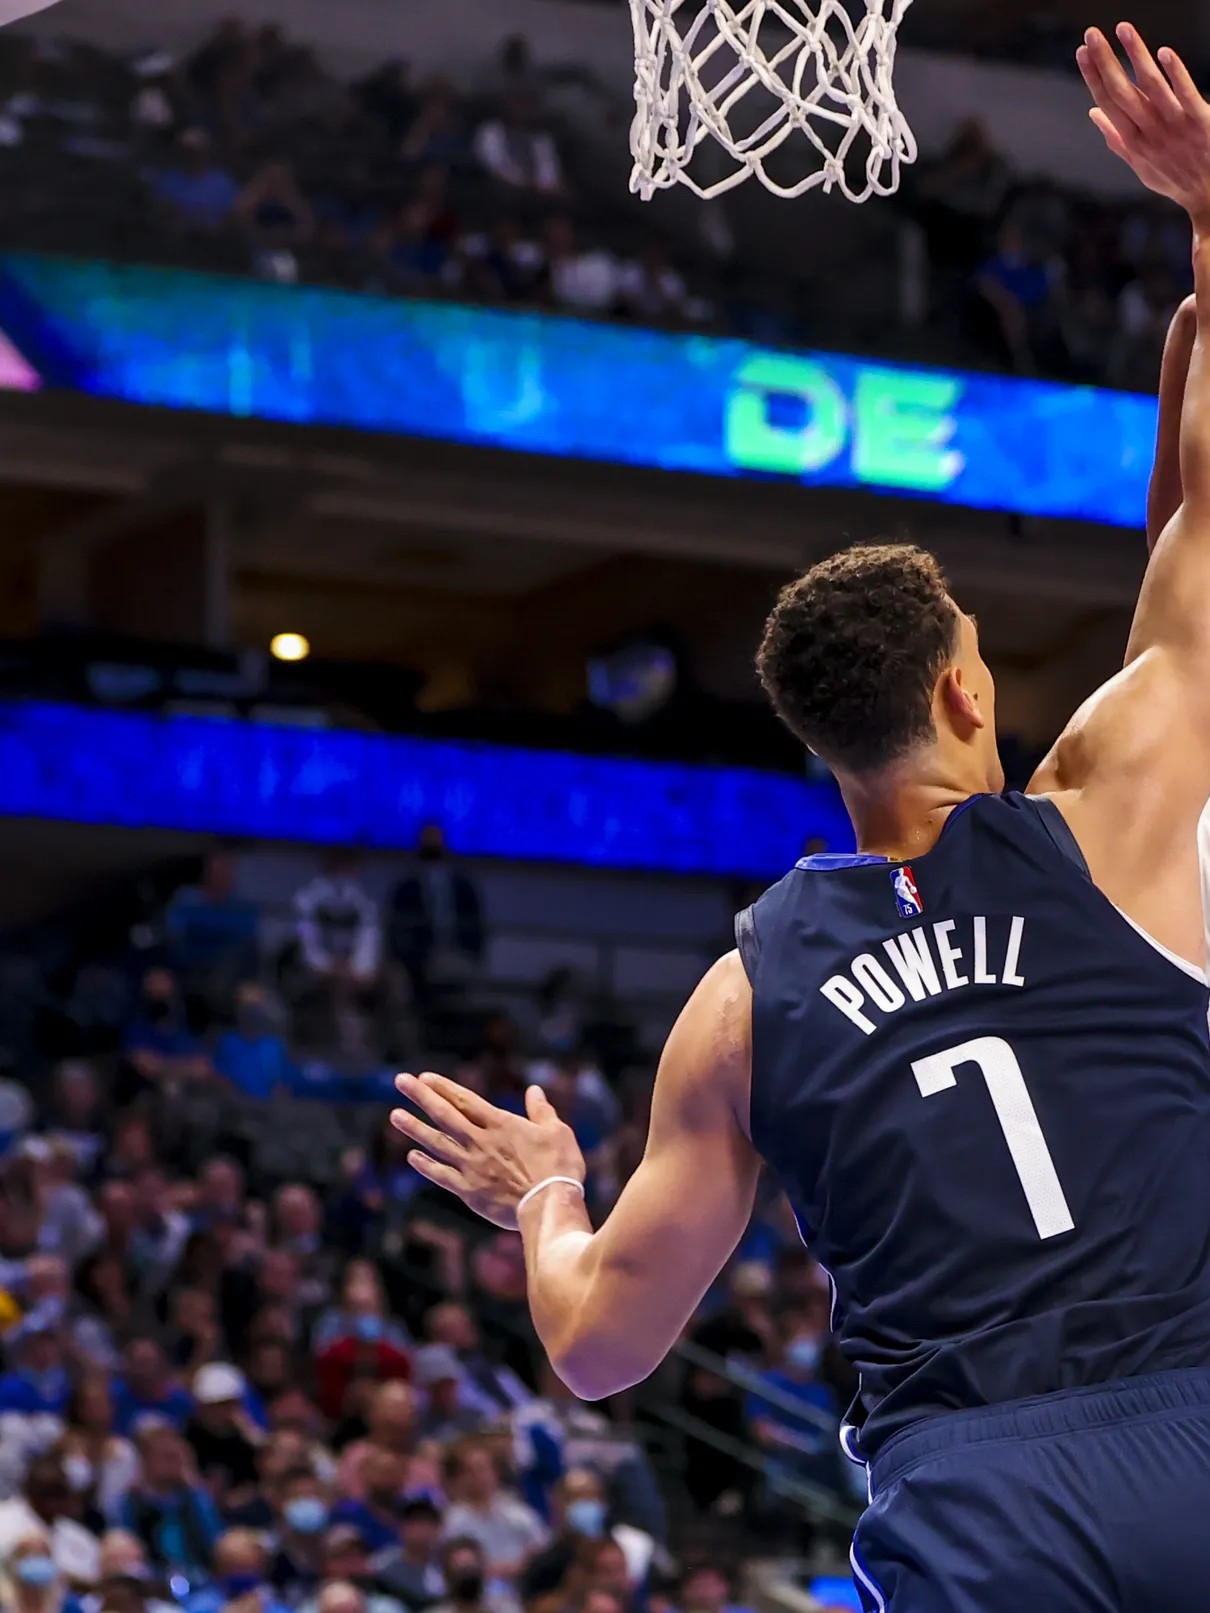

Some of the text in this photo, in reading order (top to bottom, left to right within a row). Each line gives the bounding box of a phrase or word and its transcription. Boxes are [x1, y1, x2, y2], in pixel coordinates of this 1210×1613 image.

[725, 350, 965, 491] DE
[903, 903, 914, 915] 75
[820, 916, 1025, 1036] POWELL
[910, 1036, 1075, 1240] 7
